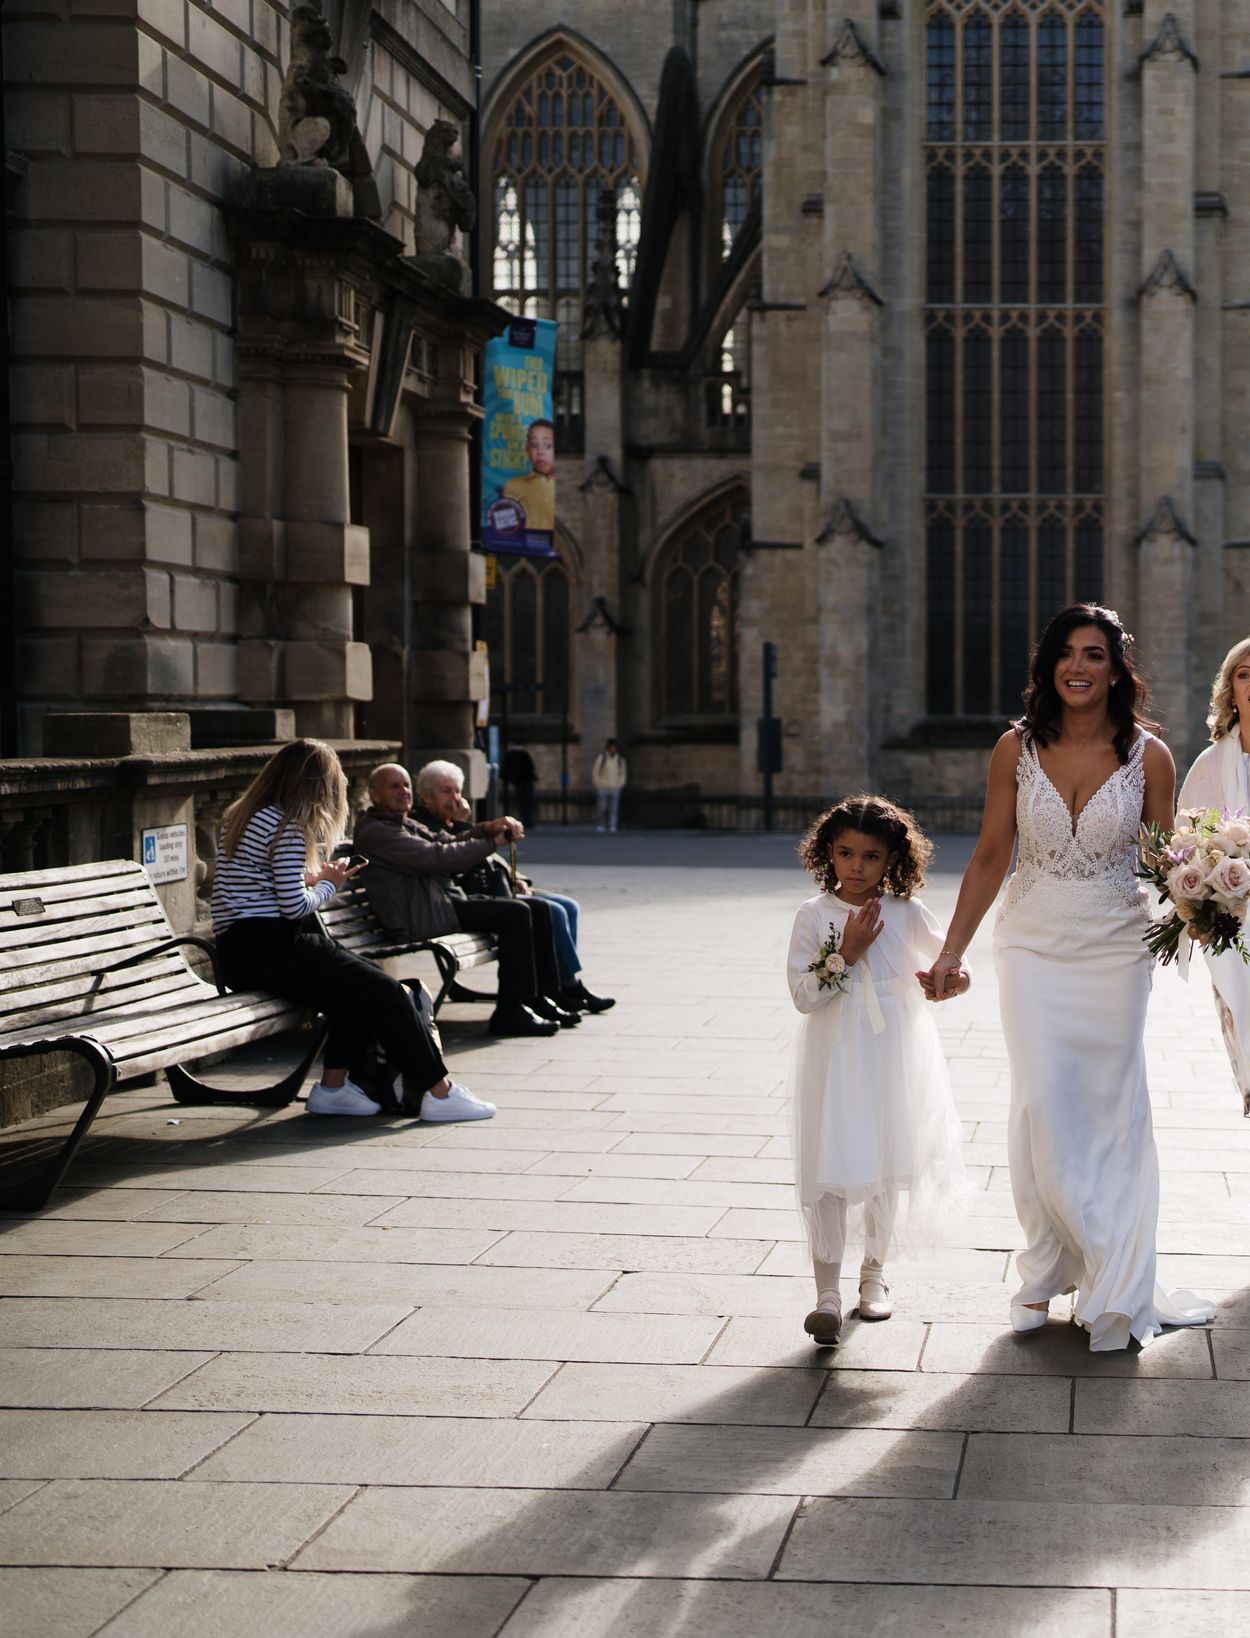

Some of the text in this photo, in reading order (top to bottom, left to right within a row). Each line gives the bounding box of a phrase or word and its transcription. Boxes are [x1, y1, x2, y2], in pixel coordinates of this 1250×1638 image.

[493, 366, 548, 394] WIPED
[160, 842, 174, 851] loading
[166, 868, 178, 876] within
